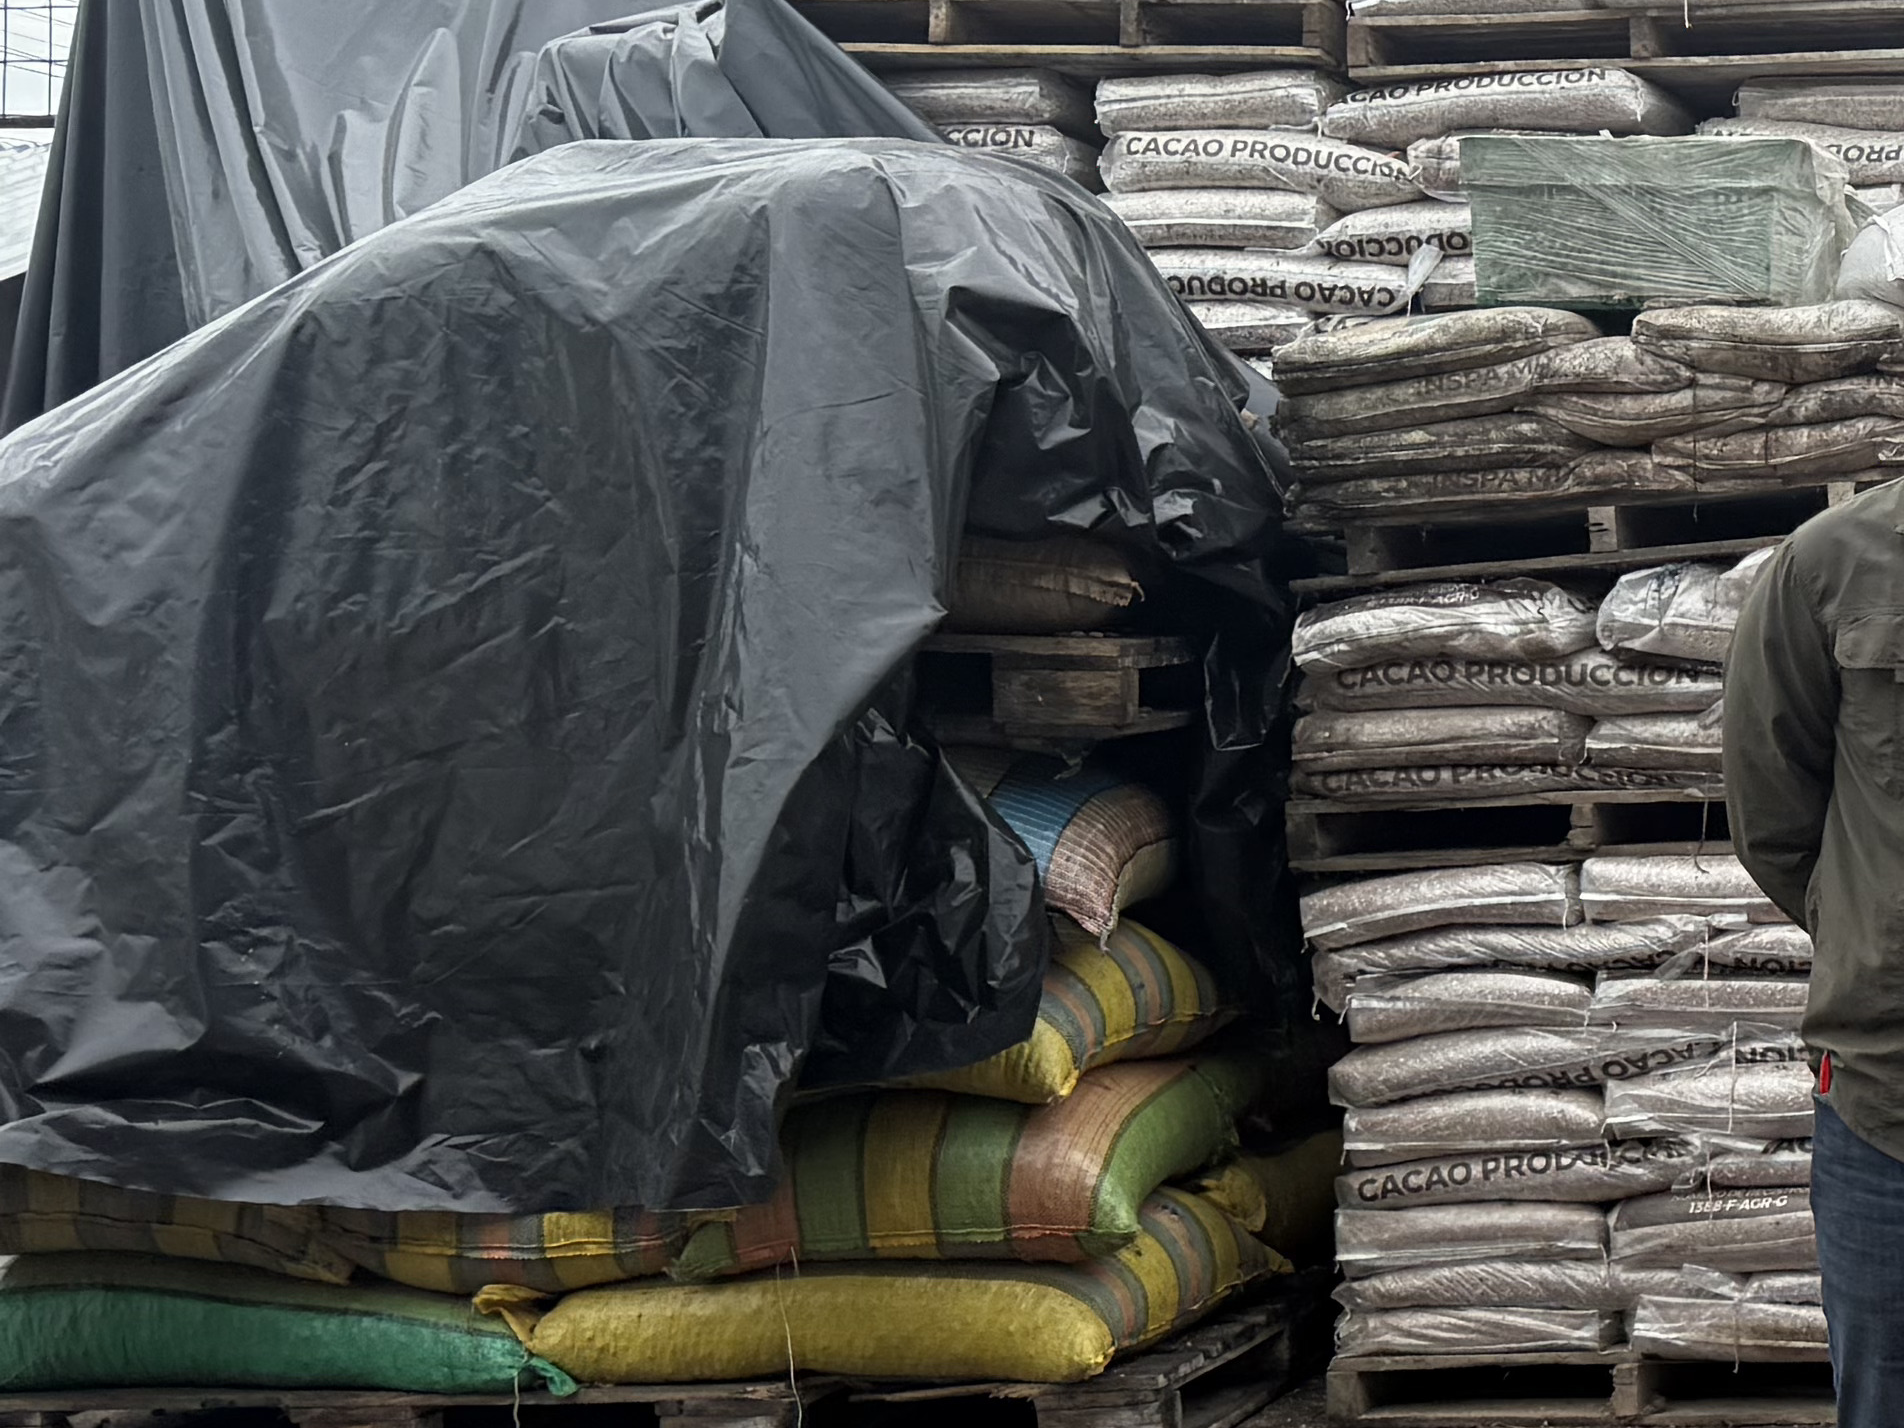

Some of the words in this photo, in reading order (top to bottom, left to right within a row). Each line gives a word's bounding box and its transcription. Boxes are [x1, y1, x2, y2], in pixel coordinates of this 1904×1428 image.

[1125, 136, 1224, 157] CACAO
[1295, 280, 1396, 307] CACAO
[1336, 662, 1455, 690] CACAO
[1356, 1163, 1472, 1202] CACAO
